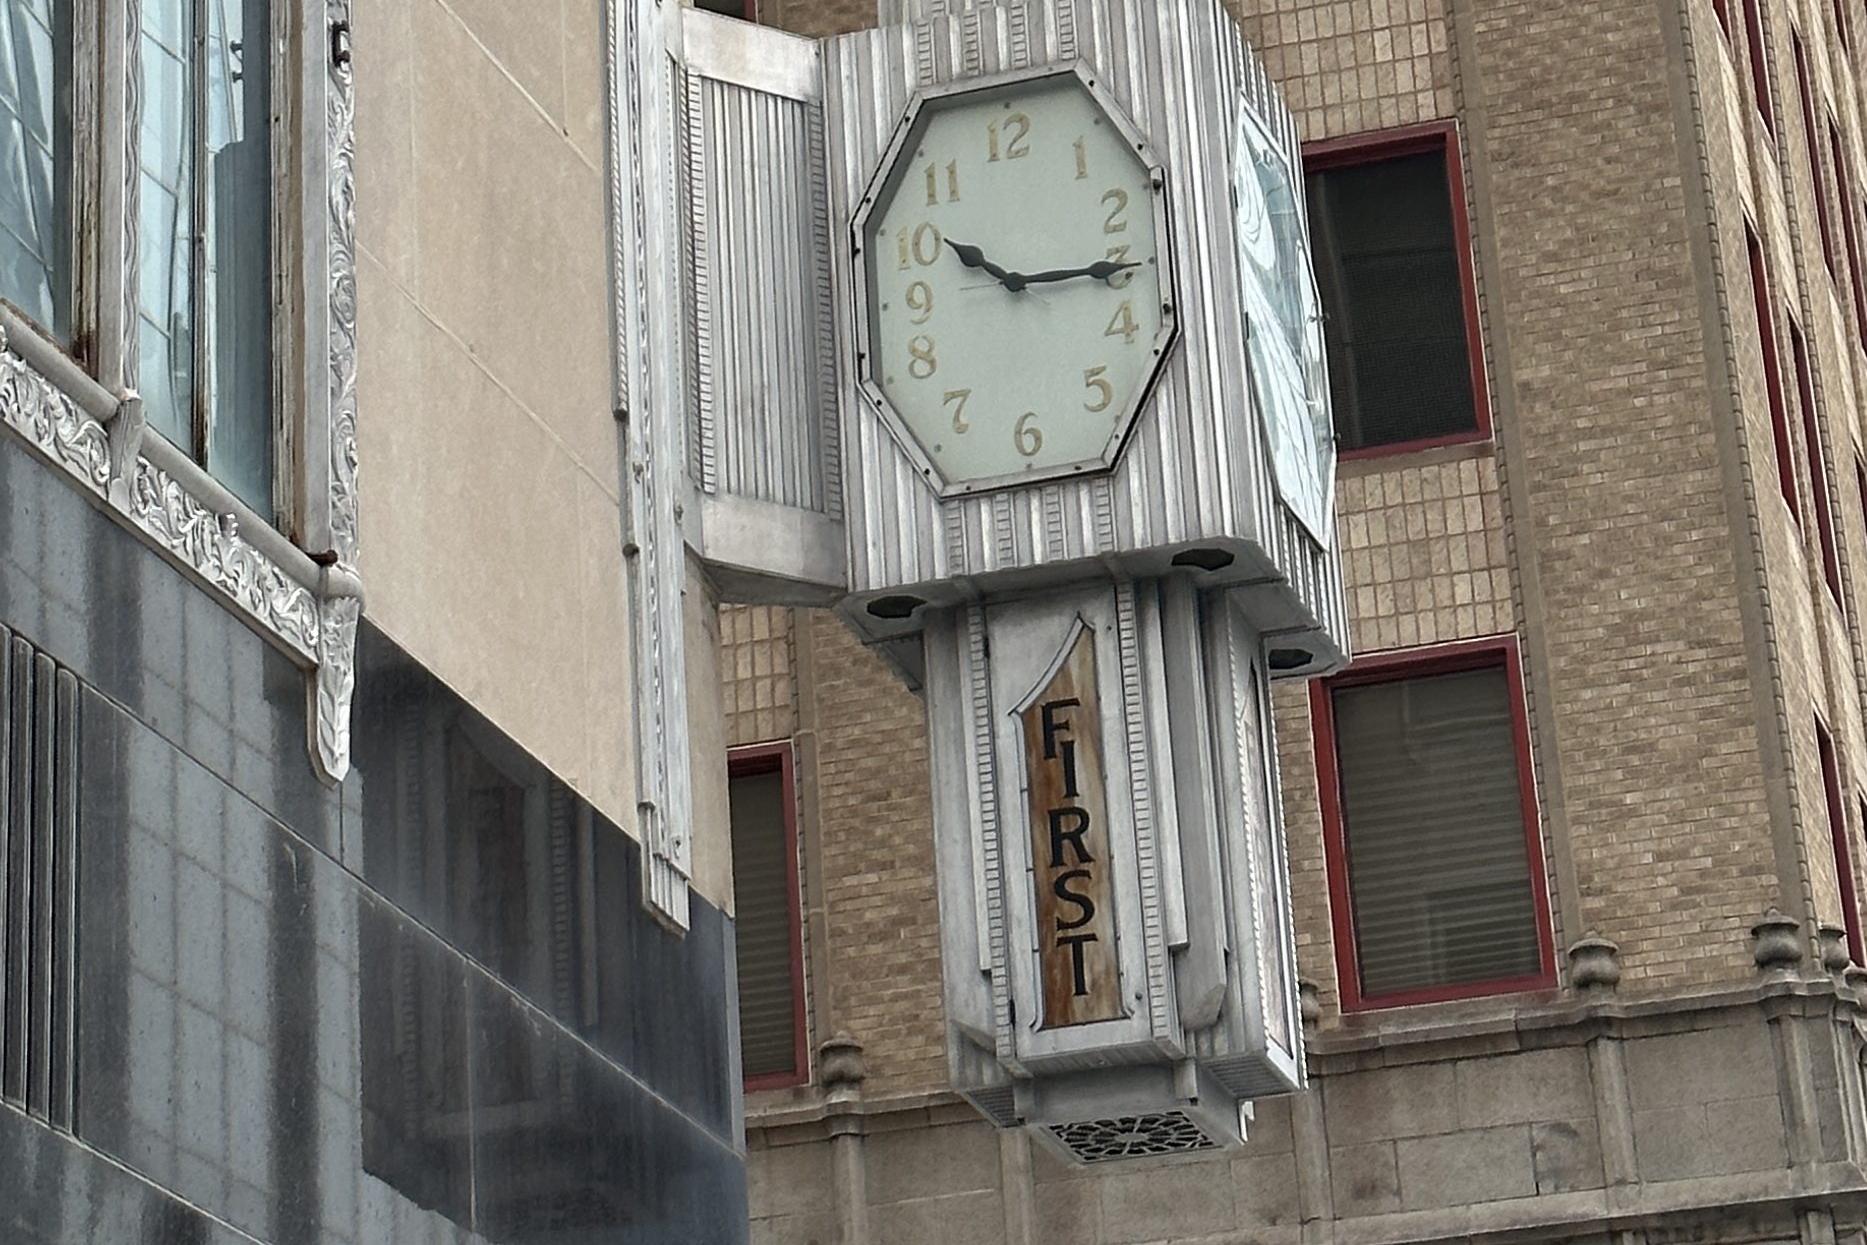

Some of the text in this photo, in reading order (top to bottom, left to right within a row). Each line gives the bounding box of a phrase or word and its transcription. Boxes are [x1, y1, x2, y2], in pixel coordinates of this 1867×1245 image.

[986, 112, 1031, 163] 12
[1073, 135, 1088, 180] 1
[924, 159, 960, 206] 11
[1101, 188, 1129, 234] 2
[895, 221, 942, 270] 10
[1105, 244, 1132, 289] 3
[905, 280, 933, 325] 9
[1104, 300, 1139, 344] 4
[907, 335, 937, 379] 8
[942, 388, 972, 434] 7
[1083, 365, 1113, 412] 5
[1014, 412, 1043, 456] 6
[1041, 698, 1099, 996] FIRST
